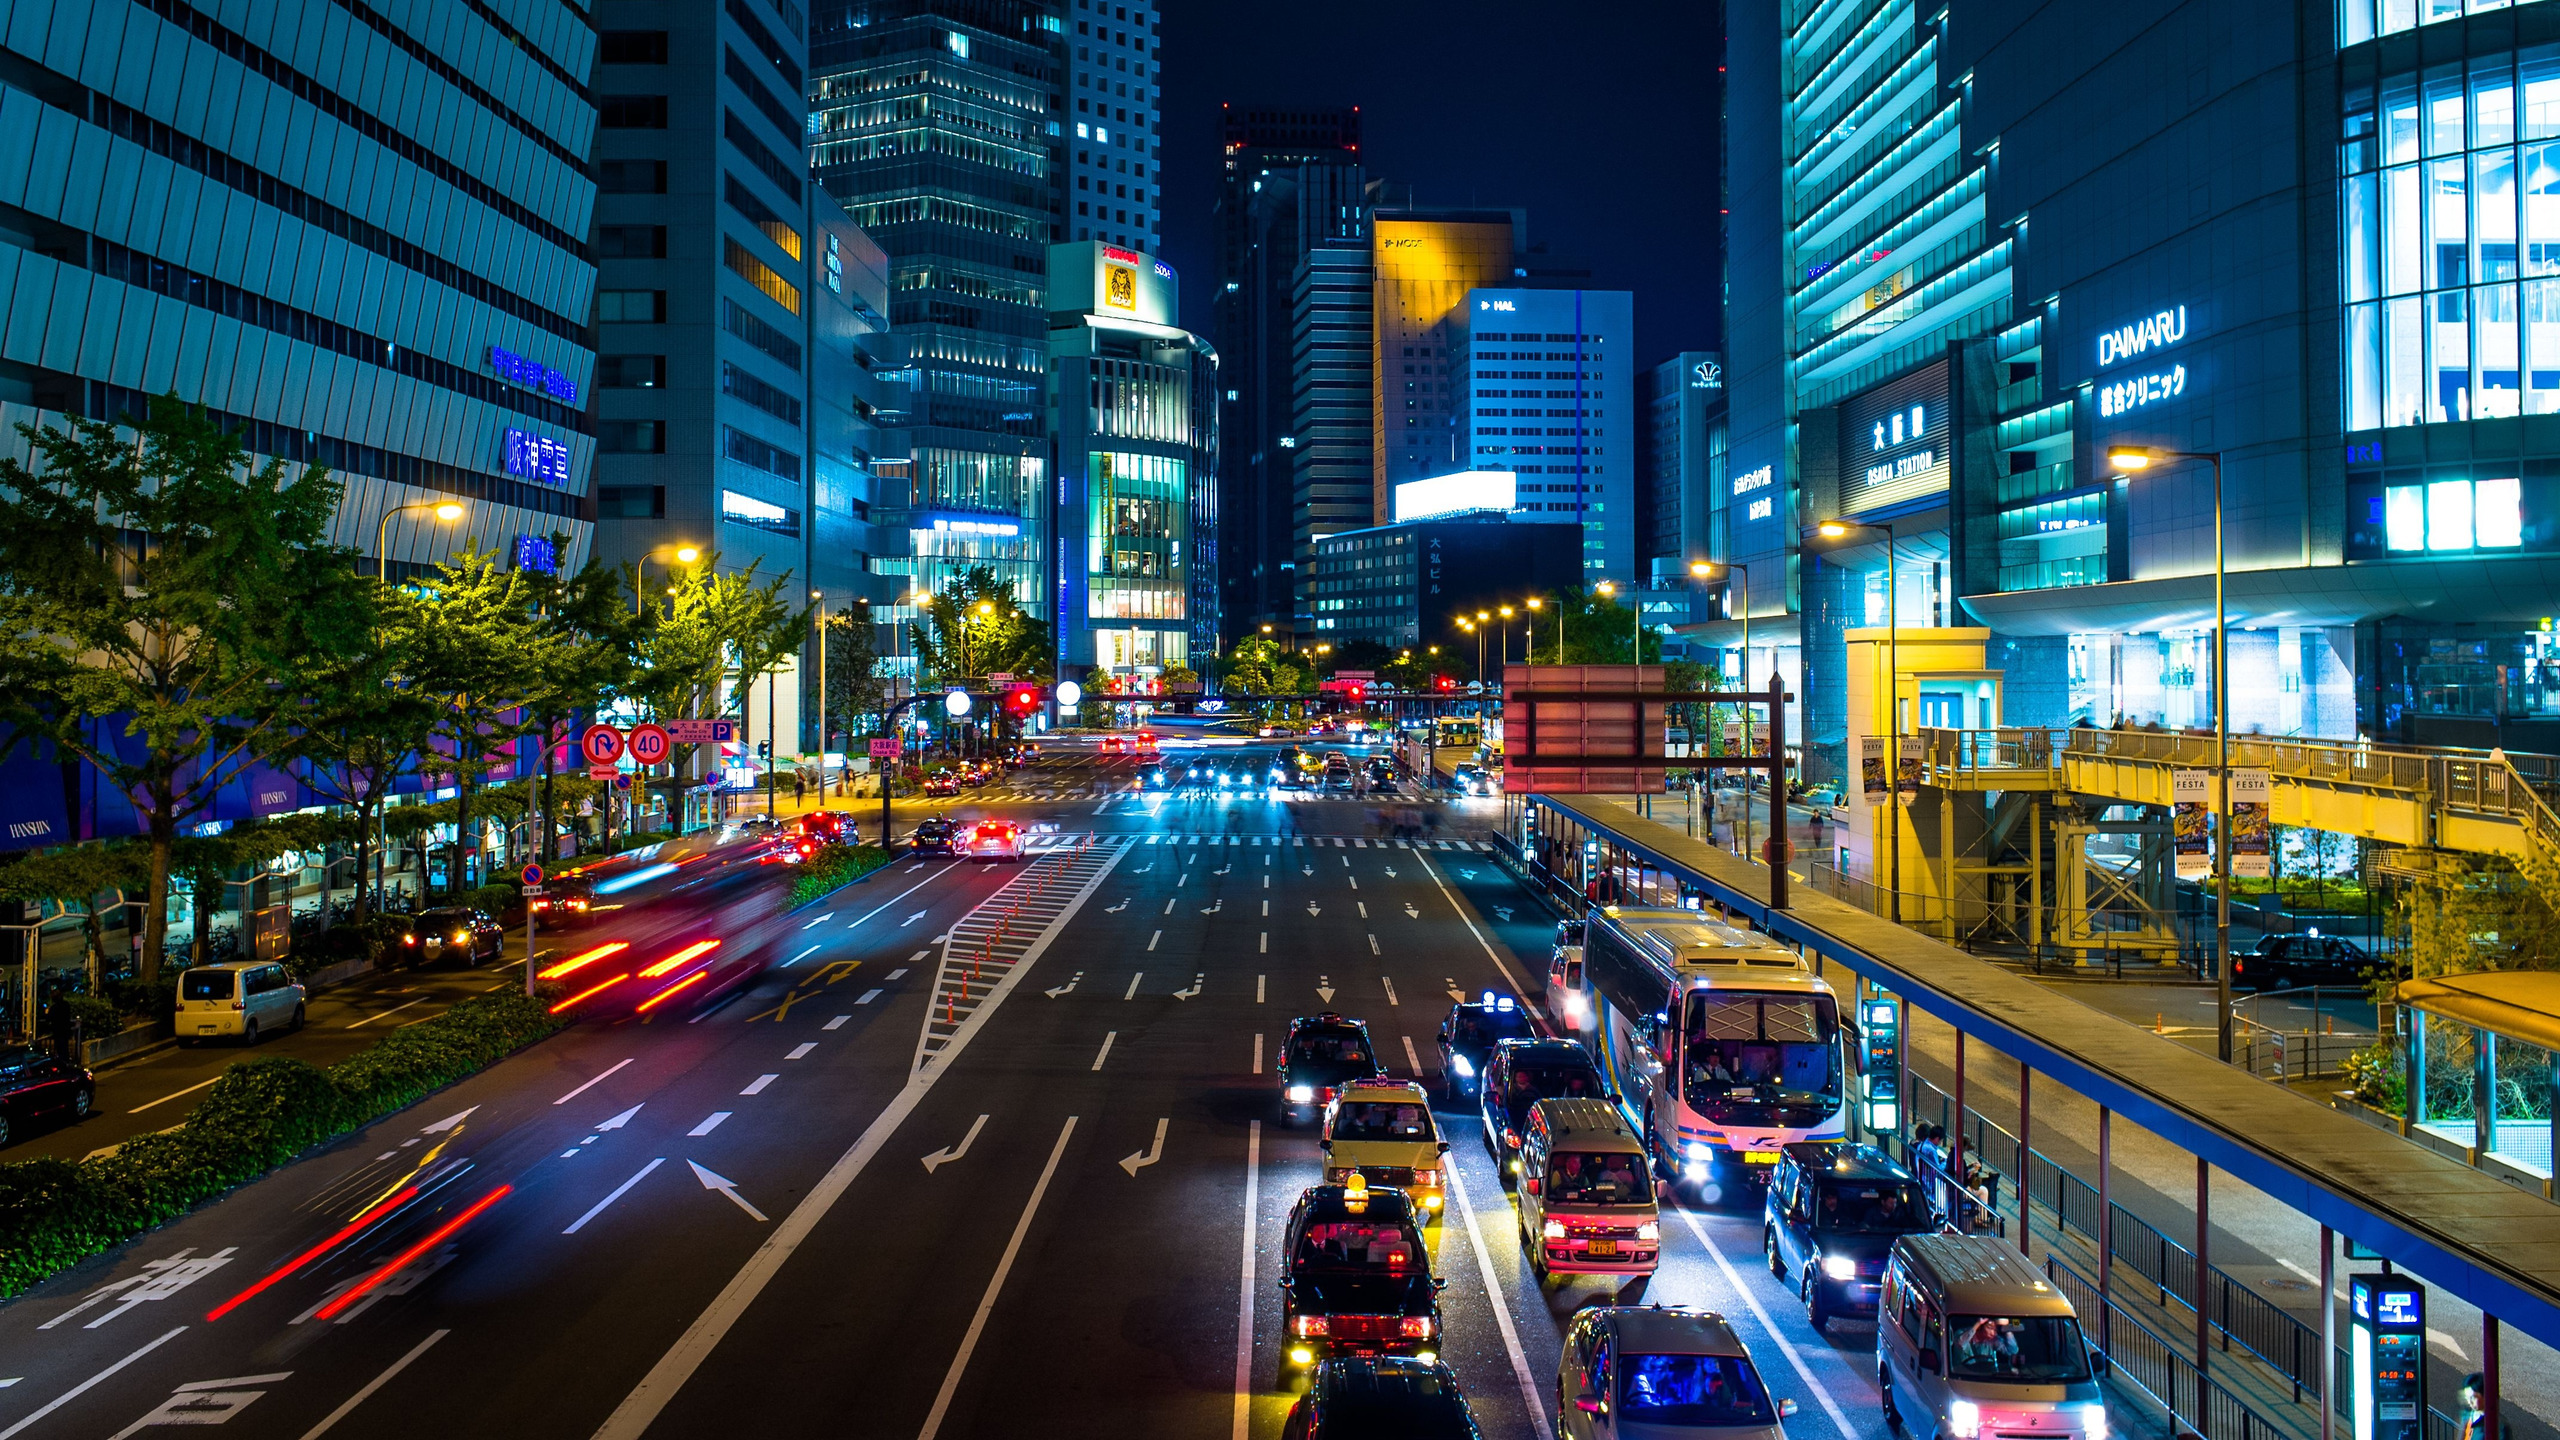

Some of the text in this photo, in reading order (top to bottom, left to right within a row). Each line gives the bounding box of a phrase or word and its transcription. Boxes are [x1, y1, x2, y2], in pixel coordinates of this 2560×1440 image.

[1395, 239, 1423, 248] MODE
[1493, 300, 1516, 311] HAL
[2099, 304, 2186, 366] DAIMARU
[2100, 364, 2186, 418] 総合クリニック
[508, 427, 568, 487] 阪神電車
[1867, 450, 1932, 486] OSAKA STATION
[1430, 538, 1441, 594] 大弘ビル
[717, 724, 728, 739] P
[638, 735, 660, 753] 40
[873, 741, 898, 749] 大阪駅前
[2176, 780, 2205, 789] FESTA
[2236, 780, 2265, 789] FESTA
[260, 790, 288, 806] HANSHIN
[9, 819, 51, 838] HANSHIN
